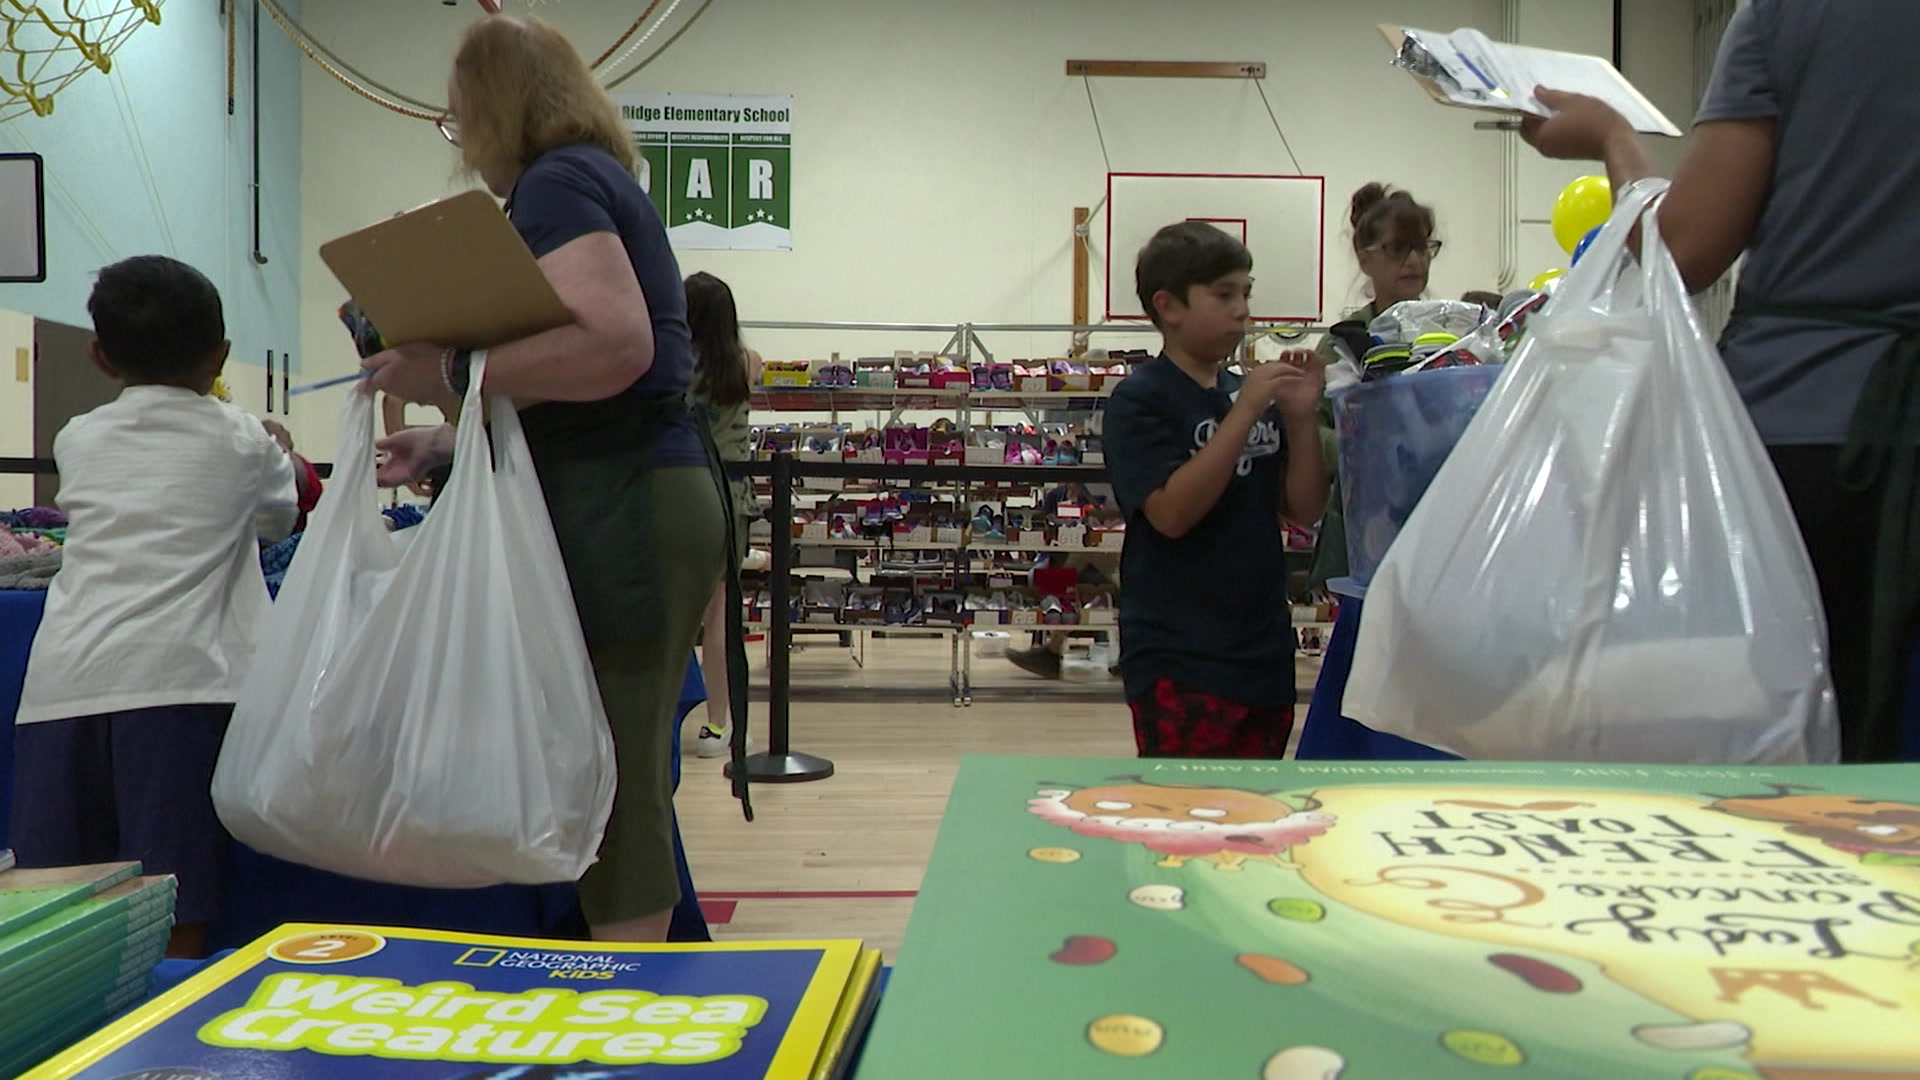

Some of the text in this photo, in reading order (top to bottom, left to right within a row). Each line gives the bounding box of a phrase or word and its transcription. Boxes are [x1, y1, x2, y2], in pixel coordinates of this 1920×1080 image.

[622, 105, 790, 123] Ridge Elementary School
[686, 158, 713, 198] A
[749, 159, 773, 199] R
[1412, 810, 1734, 838] TOAST
[1373, 831, 1846, 869] FRENCH
[1564, 903, 1911, 960] Lady
[295, 939, 347, 957] 2
[508, 951, 616, 964] NATIONAL
[499, 960, 641, 972] GEOGRAPHIC
[548, 970, 617, 980] KIDS
[266, 978, 749, 1025] Weird Sea
[219, 1009, 726, 1057] Creatures
